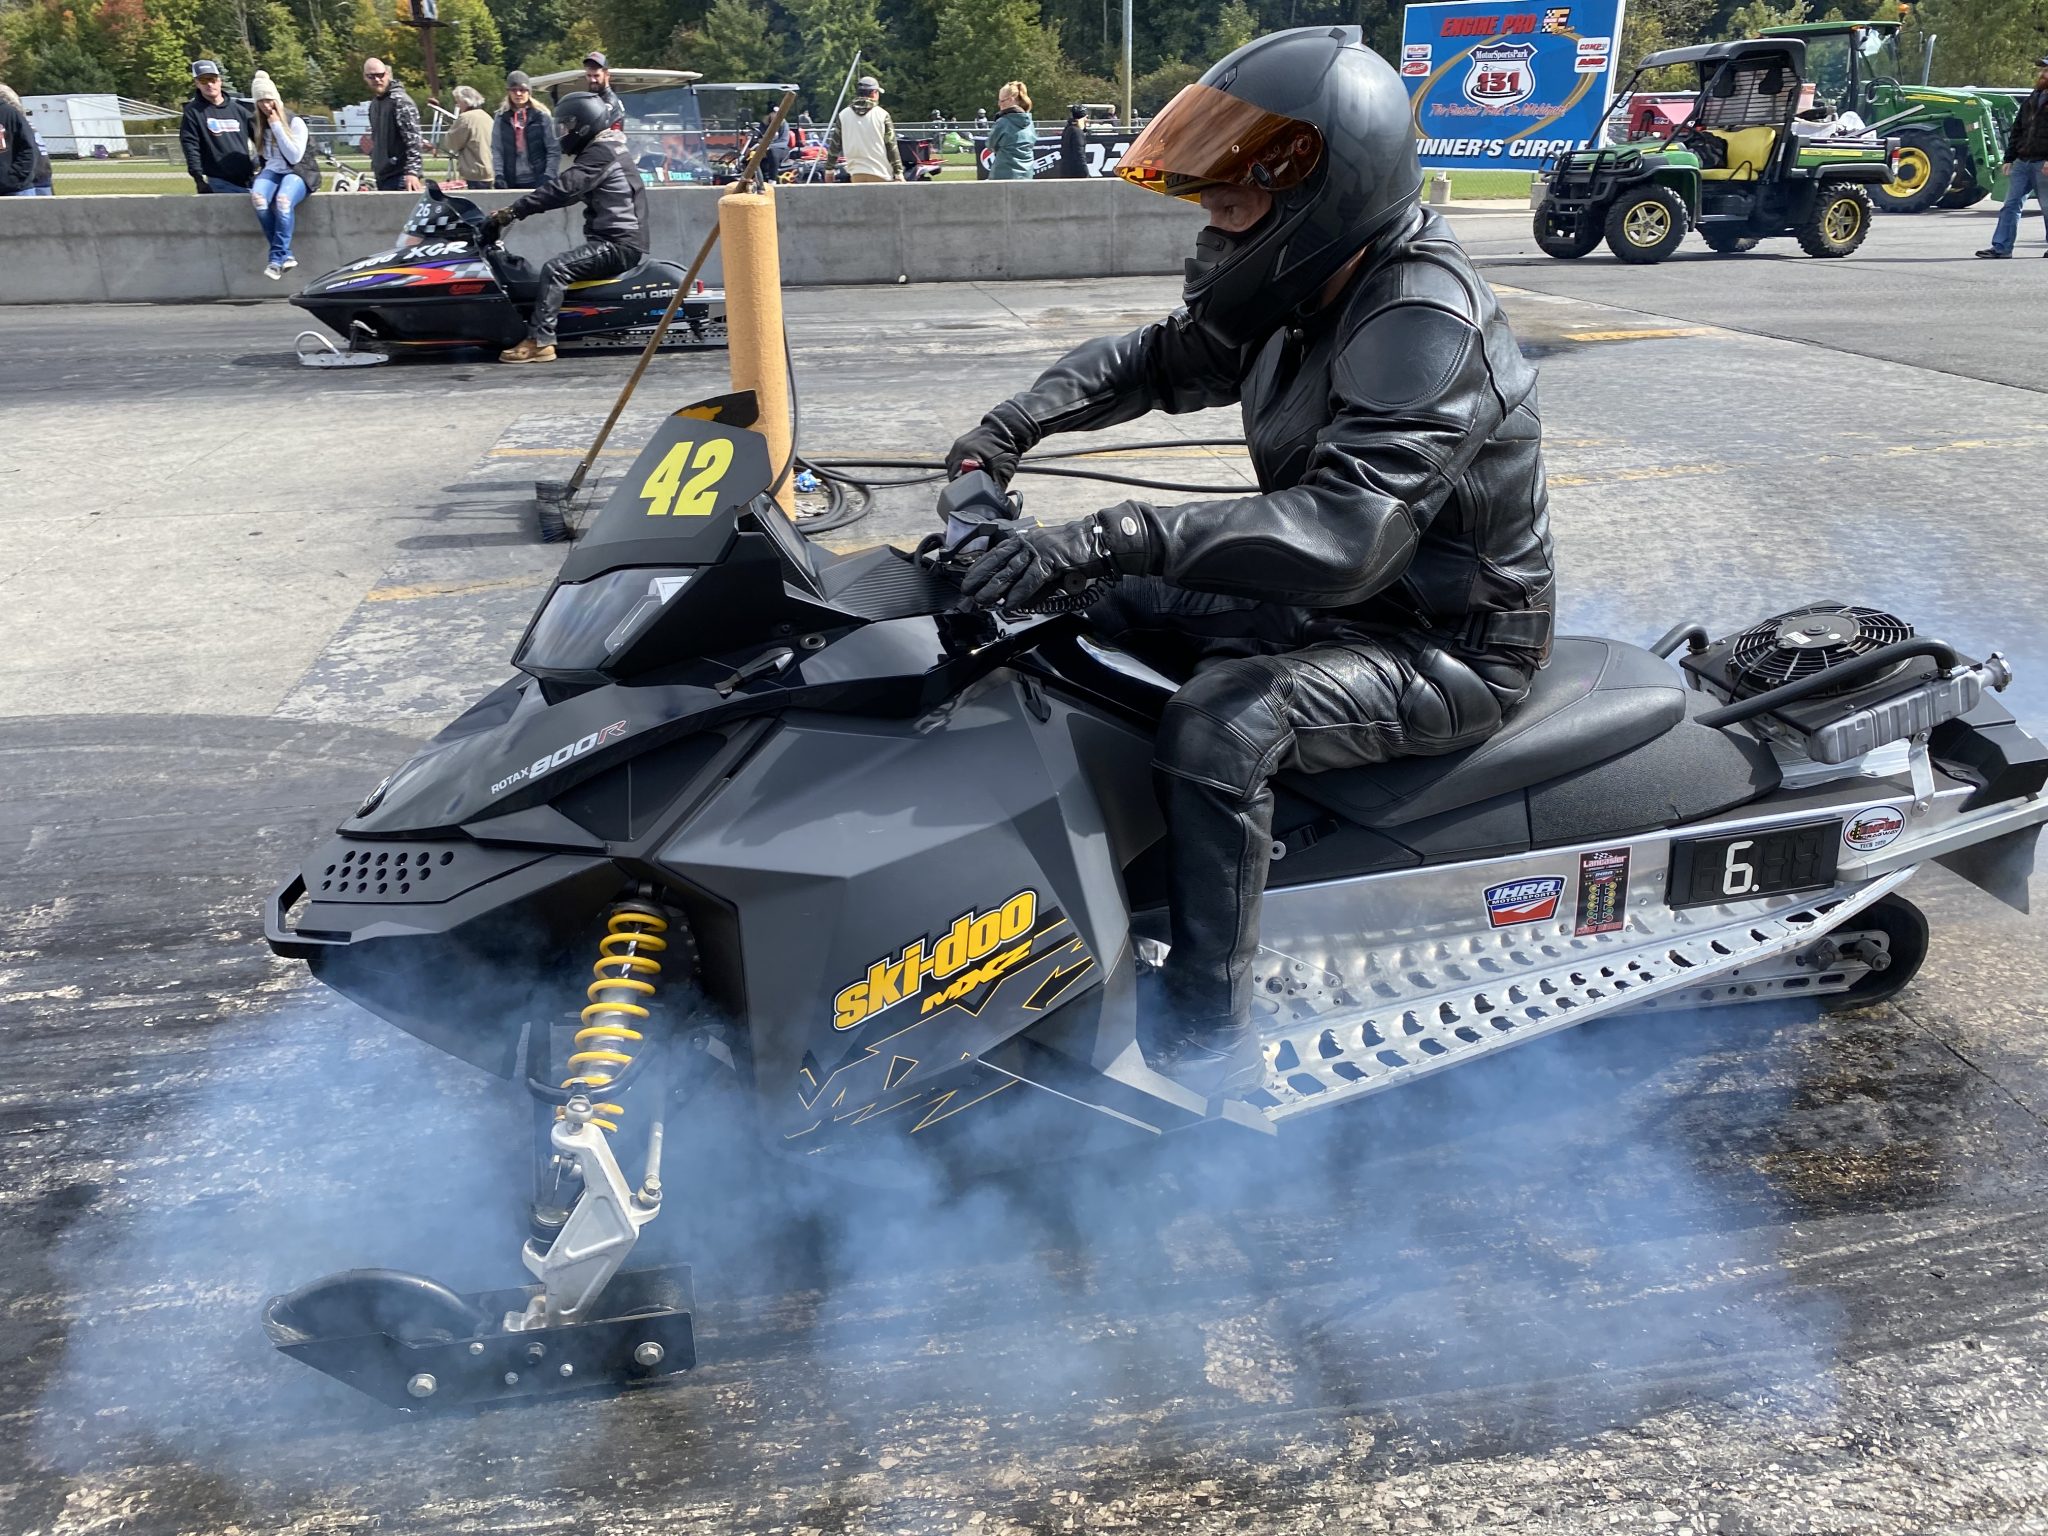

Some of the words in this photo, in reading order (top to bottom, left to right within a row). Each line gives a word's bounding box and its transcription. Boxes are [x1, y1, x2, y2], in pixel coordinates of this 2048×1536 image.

[1440, 17, 1499, 37] ENGINE
[1502, 14, 1537, 35] PRO
[1477, 72, 1520, 92] 131
[1416, 138, 1504, 156] INNER'S
[416, 204, 431, 217] 26
[403, 241, 468, 259] XCR
[640, 438, 734, 516] 42
[491, 767, 529, 794] ROTAX
[528, 720, 627, 779] 800R
[1583, 855, 1627, 868] Lancaster
[1491, 891, 1557, 905] MOTORSPORTS
[1493, 881, 1556, 900] IHRA
[834, 891, 1037, 1031] ski-doo
